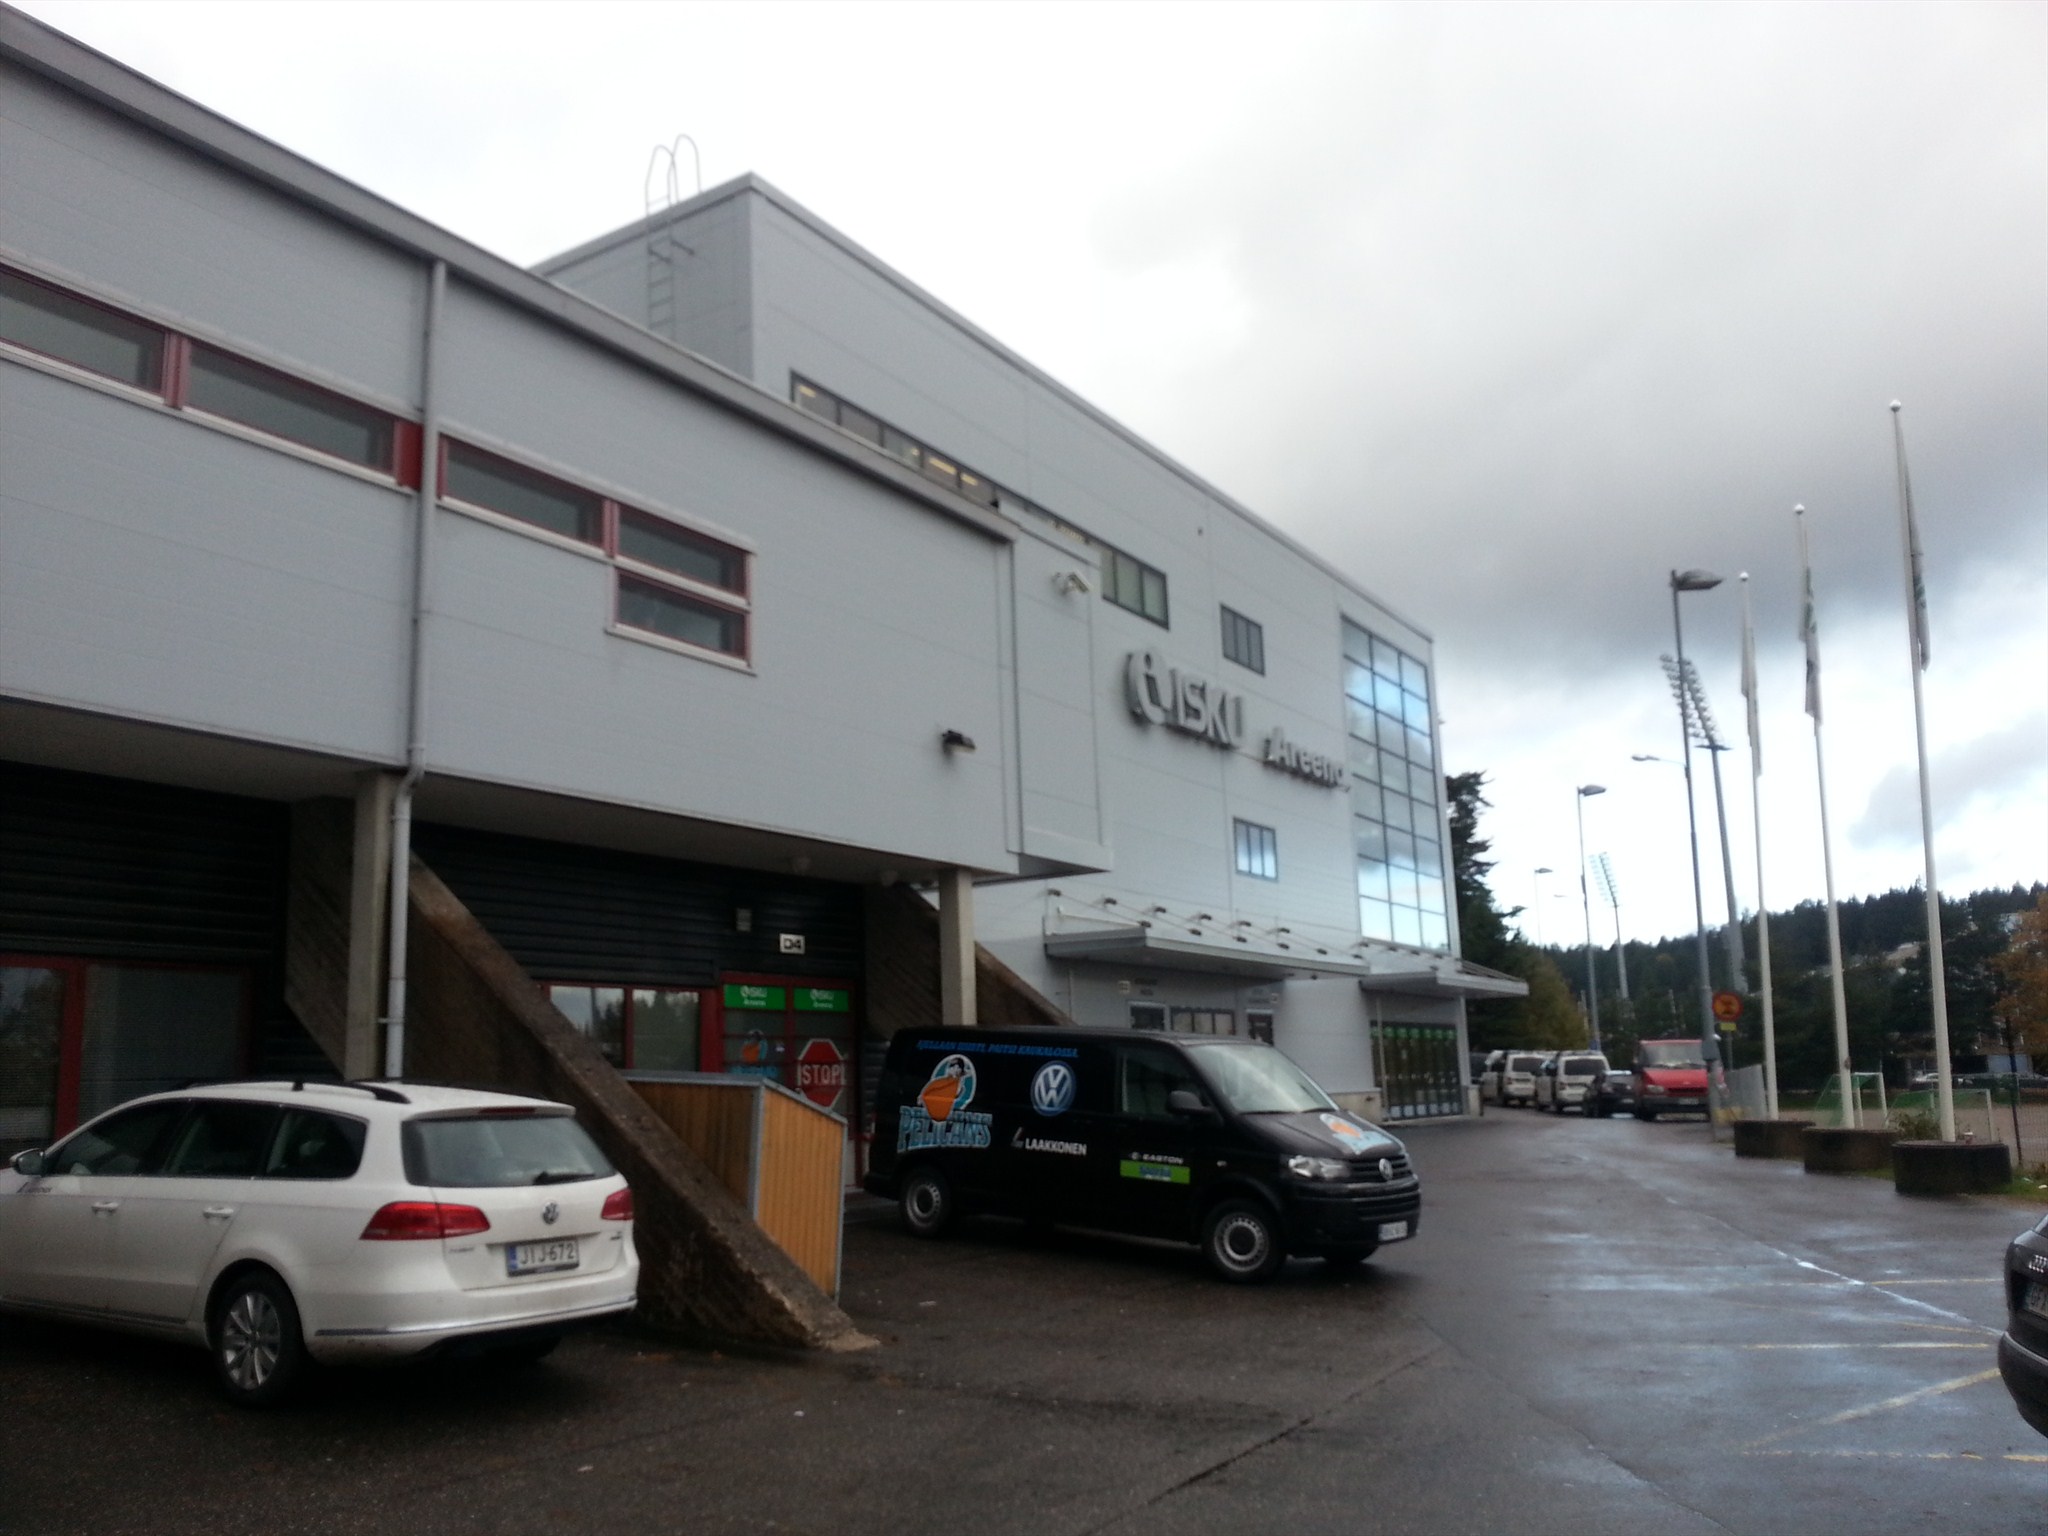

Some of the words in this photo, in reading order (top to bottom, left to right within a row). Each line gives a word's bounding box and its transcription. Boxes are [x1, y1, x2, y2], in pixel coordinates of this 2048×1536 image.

[801, 1064, 841, 1086] STOP
[897, 1105, 992, 1153] PELICANS
[1025, 1138, 1088, 1156] LAAKKONEN
